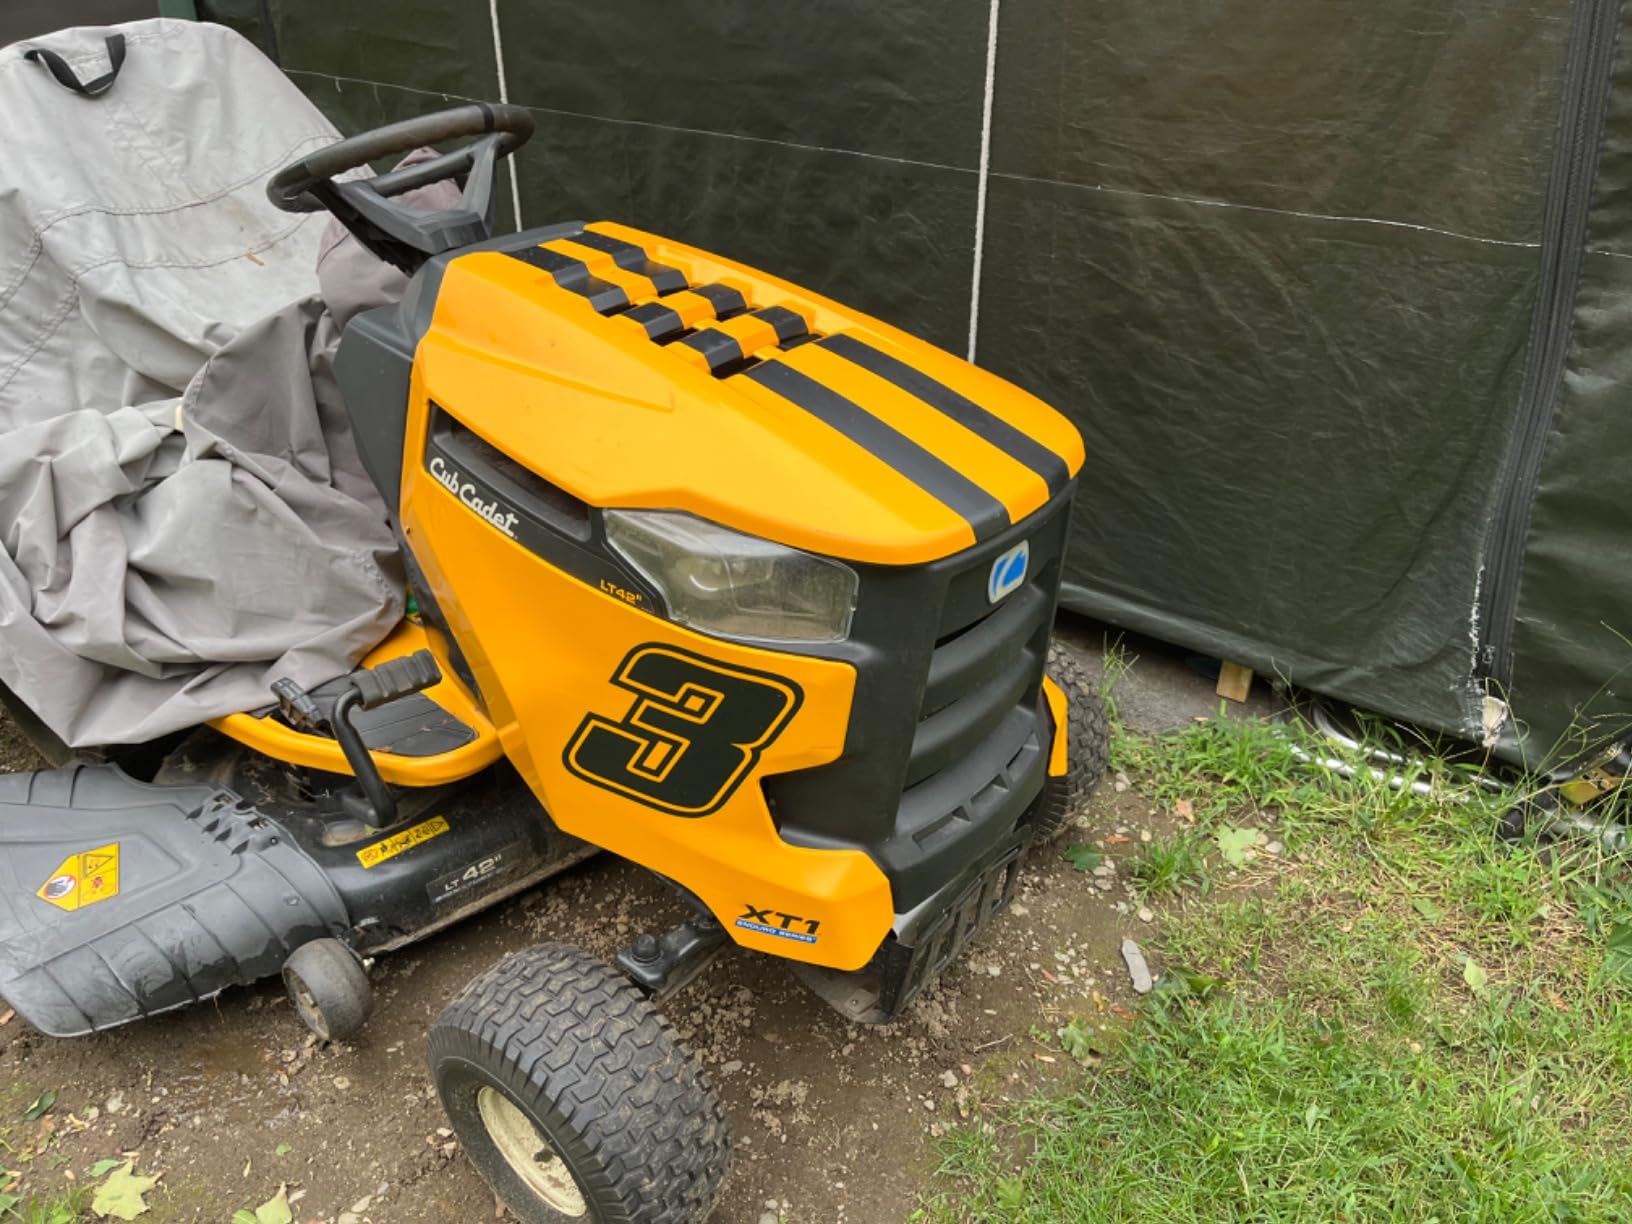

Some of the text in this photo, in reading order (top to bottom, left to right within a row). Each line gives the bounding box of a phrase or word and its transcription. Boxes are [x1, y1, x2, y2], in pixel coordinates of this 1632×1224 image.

[430, 457, 519, 537] Cub Cadet
[562, 641, 805, 818] 3
[738, 904, 821, 935] XT1
